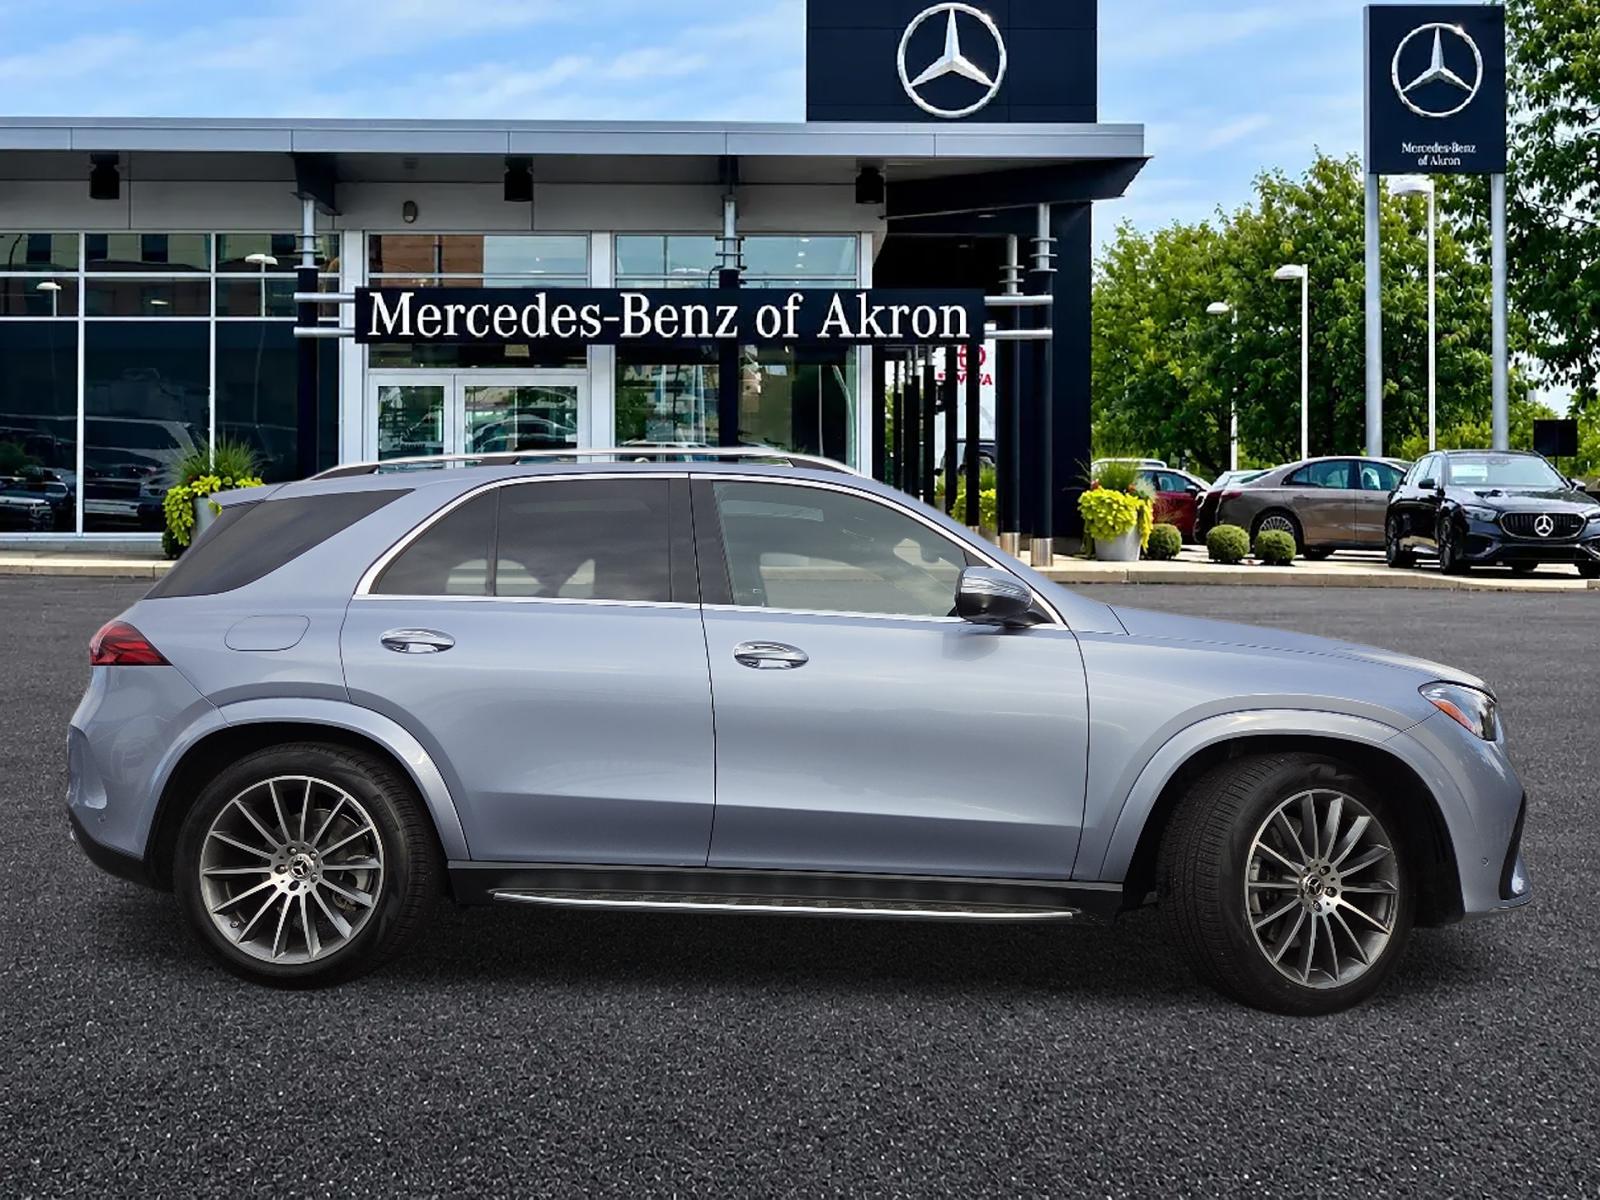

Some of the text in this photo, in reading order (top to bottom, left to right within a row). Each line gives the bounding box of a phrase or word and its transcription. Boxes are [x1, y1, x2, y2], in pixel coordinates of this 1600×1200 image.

[1401, 142, 1477, 153] Mercedes-Benz
[1417, 155, 1461, 166] of Akron
[368, 291, 971, 338] Mercedes-Benz of Akron
